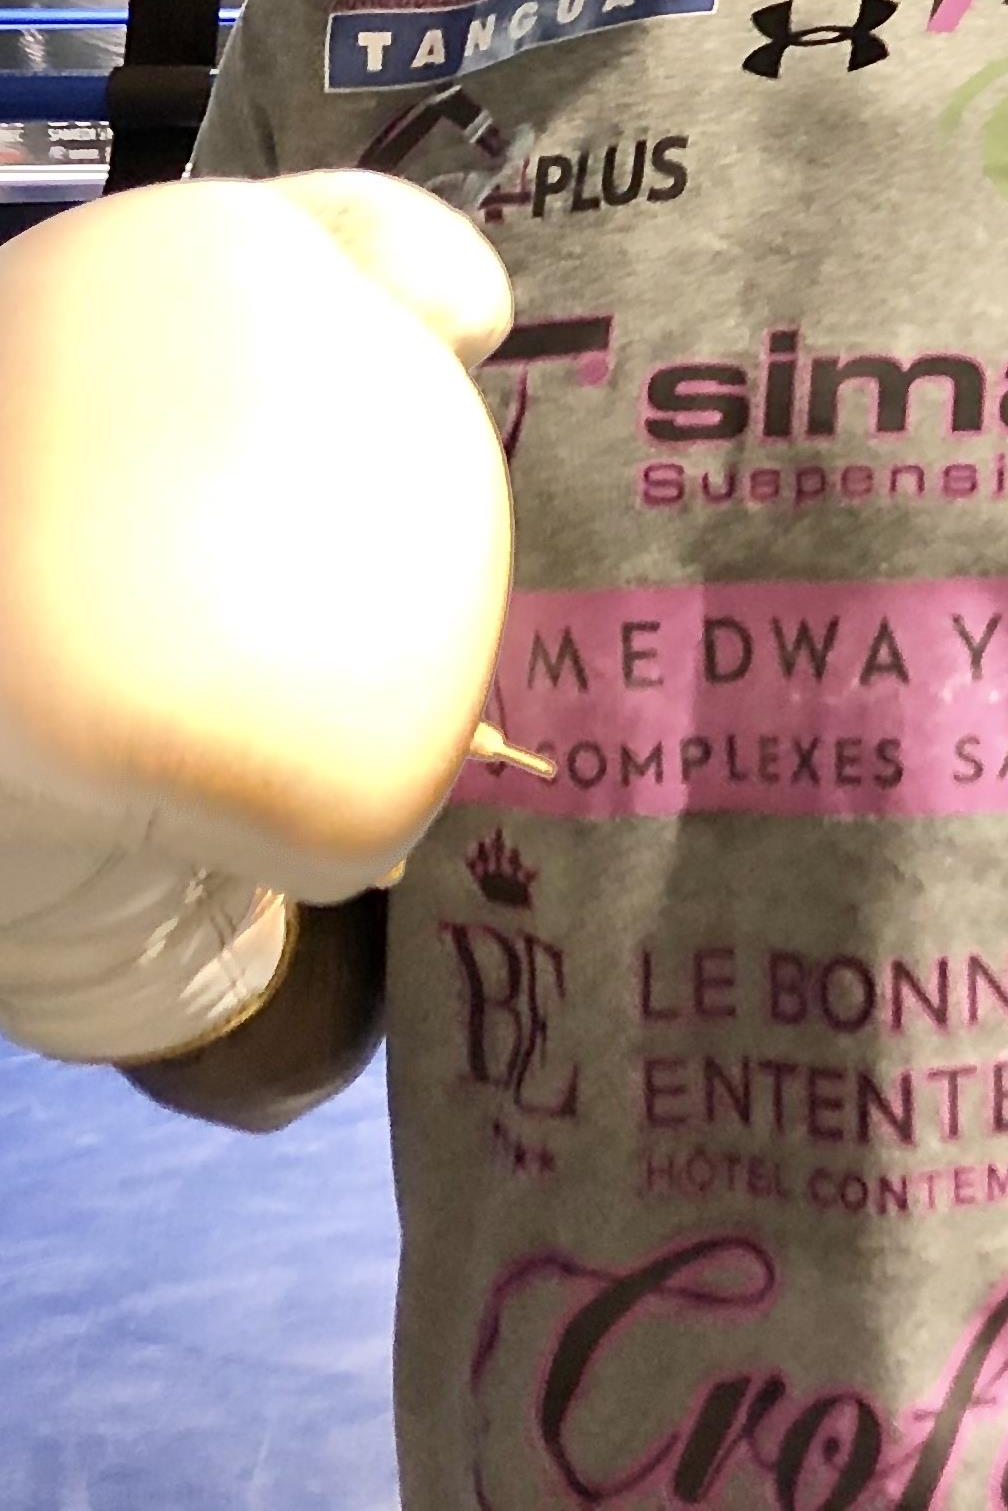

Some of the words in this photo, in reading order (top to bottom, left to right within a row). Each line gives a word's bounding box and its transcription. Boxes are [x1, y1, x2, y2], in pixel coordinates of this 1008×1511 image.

[531, 133, 691, 219] PLUS
[527, 612, 1003, 694] MEDWAY
[641, 945, 737, 1020] LE
